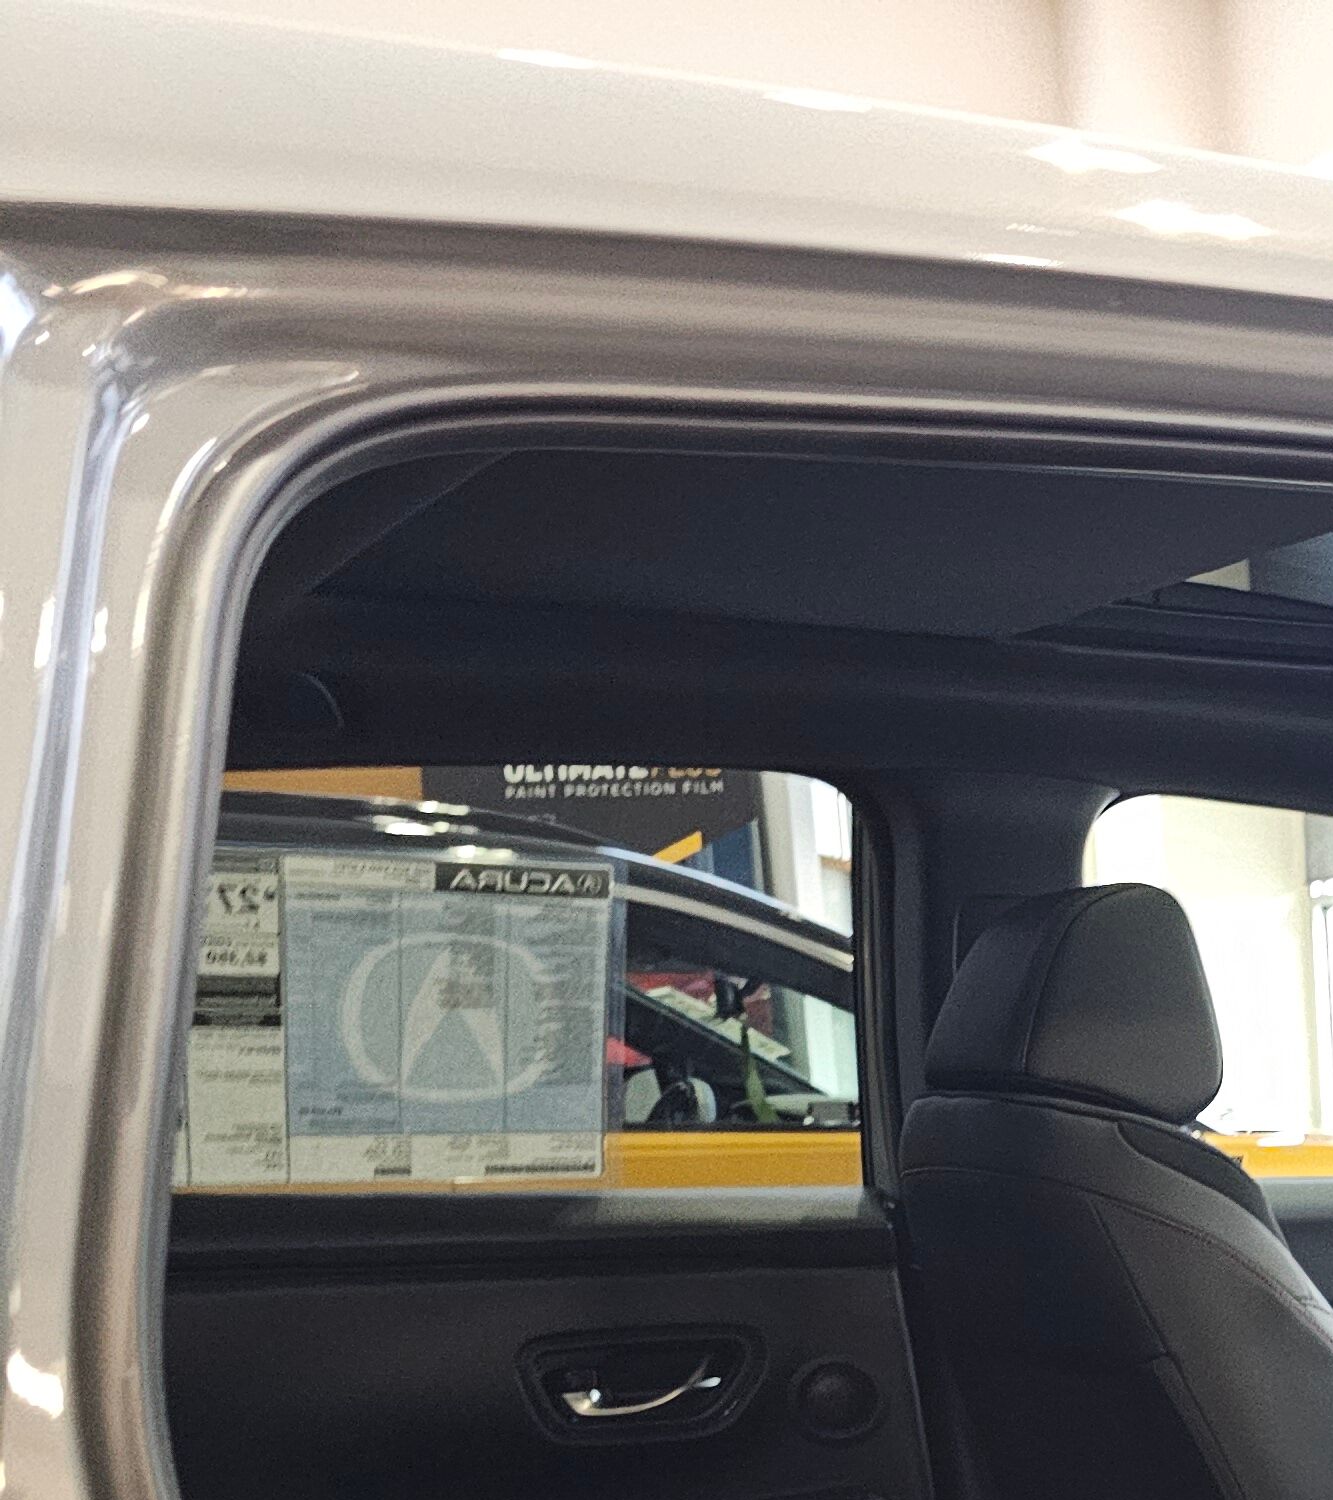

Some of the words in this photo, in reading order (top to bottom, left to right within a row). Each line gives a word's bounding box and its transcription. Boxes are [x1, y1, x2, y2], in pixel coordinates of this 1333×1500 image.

[504, 783, 556, 799] PAINT
[564, 781, 676, 798] PROTECTION
[682, 779, 724, 795] FILM
